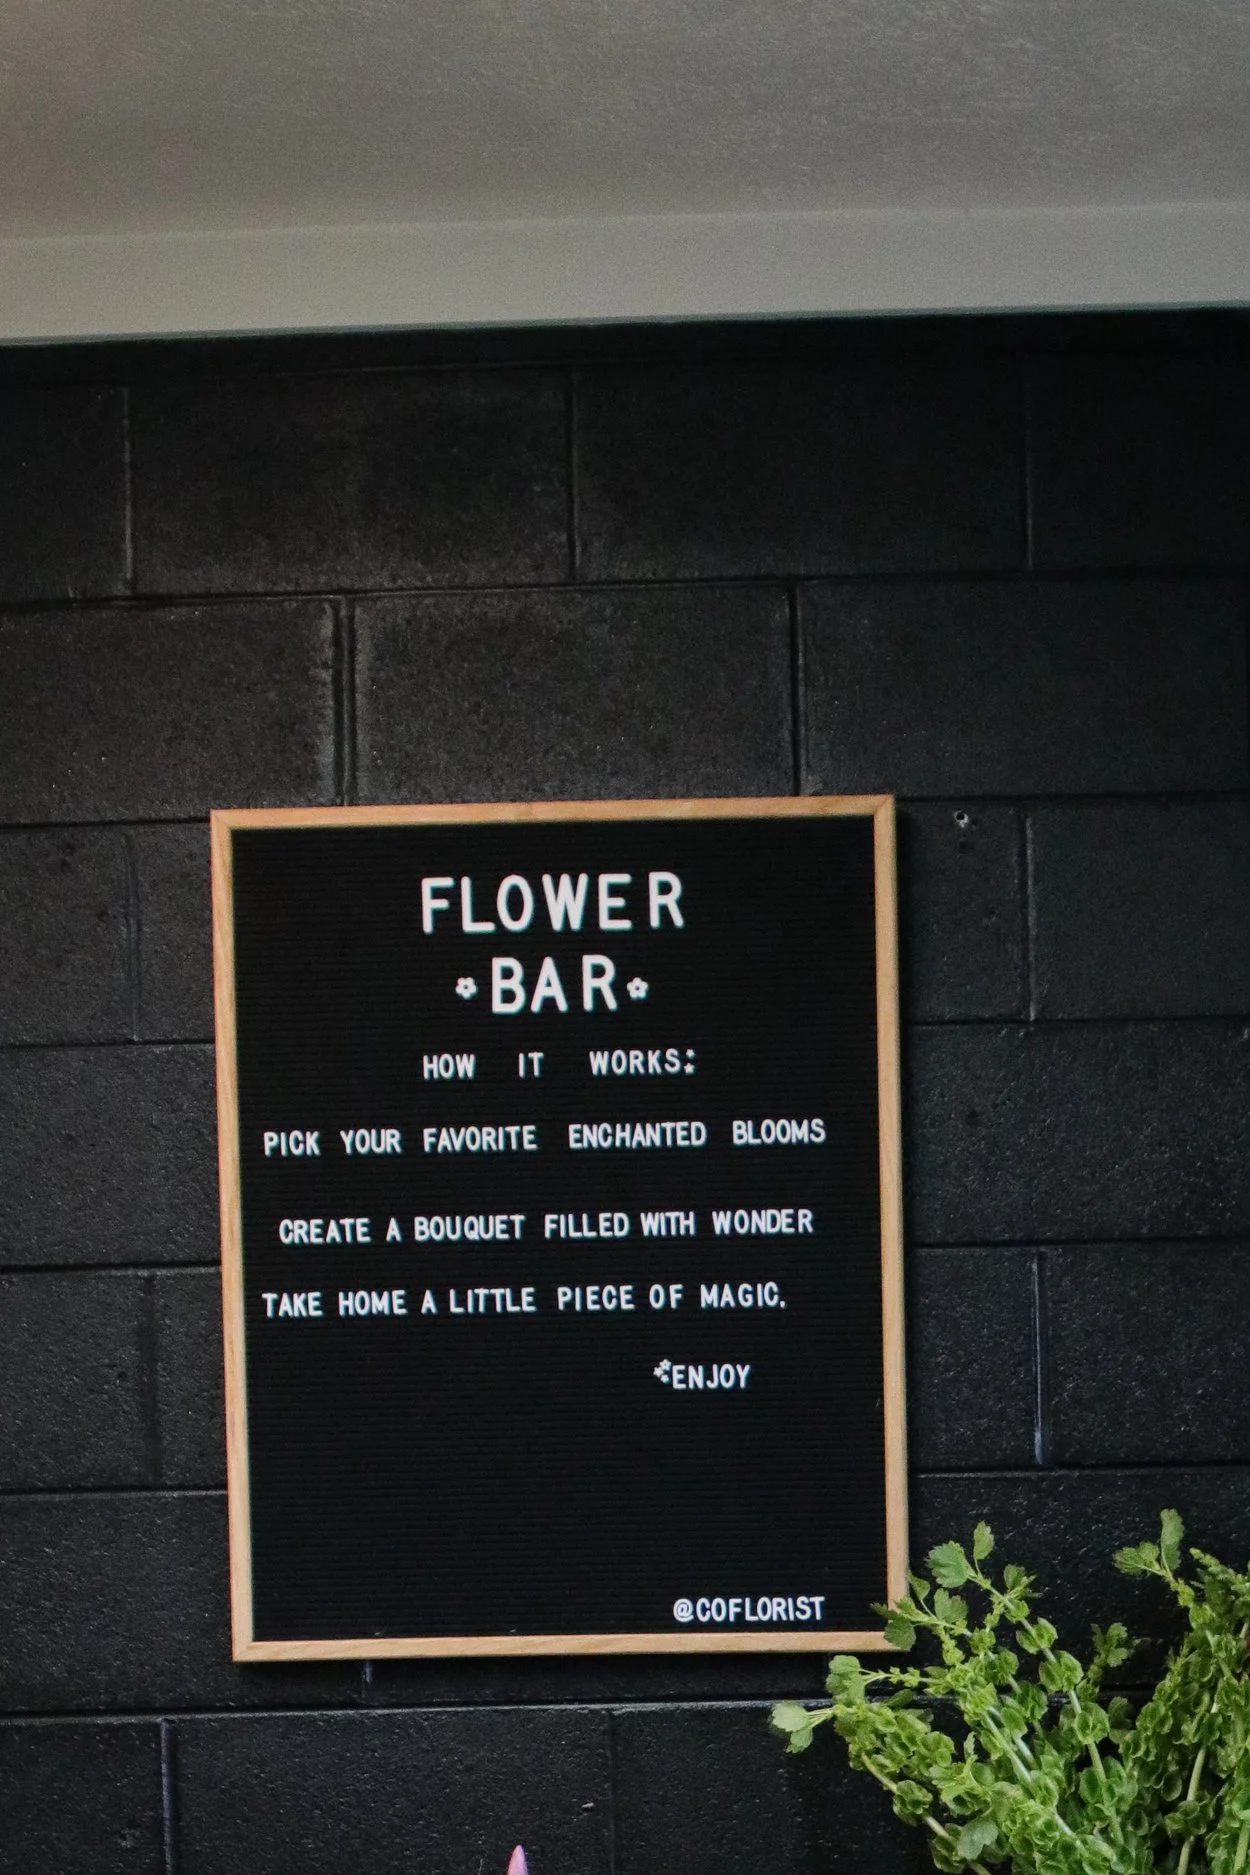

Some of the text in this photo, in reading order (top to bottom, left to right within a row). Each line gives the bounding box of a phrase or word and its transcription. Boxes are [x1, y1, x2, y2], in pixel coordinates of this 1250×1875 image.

[421, 871, 684, 934] FLOWER
[491, 954, 617, 1014] BAR
[422, 1053, 475, 1080] HOW
[518, 1051, 544, 1078] IT
[263, 1118, 826, 1156] PICK YOUR FAVORITE ENCHANTED BLOOMS
[278, 1208, 813, 1245] CREATE A BOUQUET FILLED WITH WONDER
[261, 1281, 786, 1318] TAKE HOME A LITTLE PIECE OF MAGIC.
[671, 1361, 750, 1390] ENJOY
[672, 1595, 825, 1623] @COFLORIST
